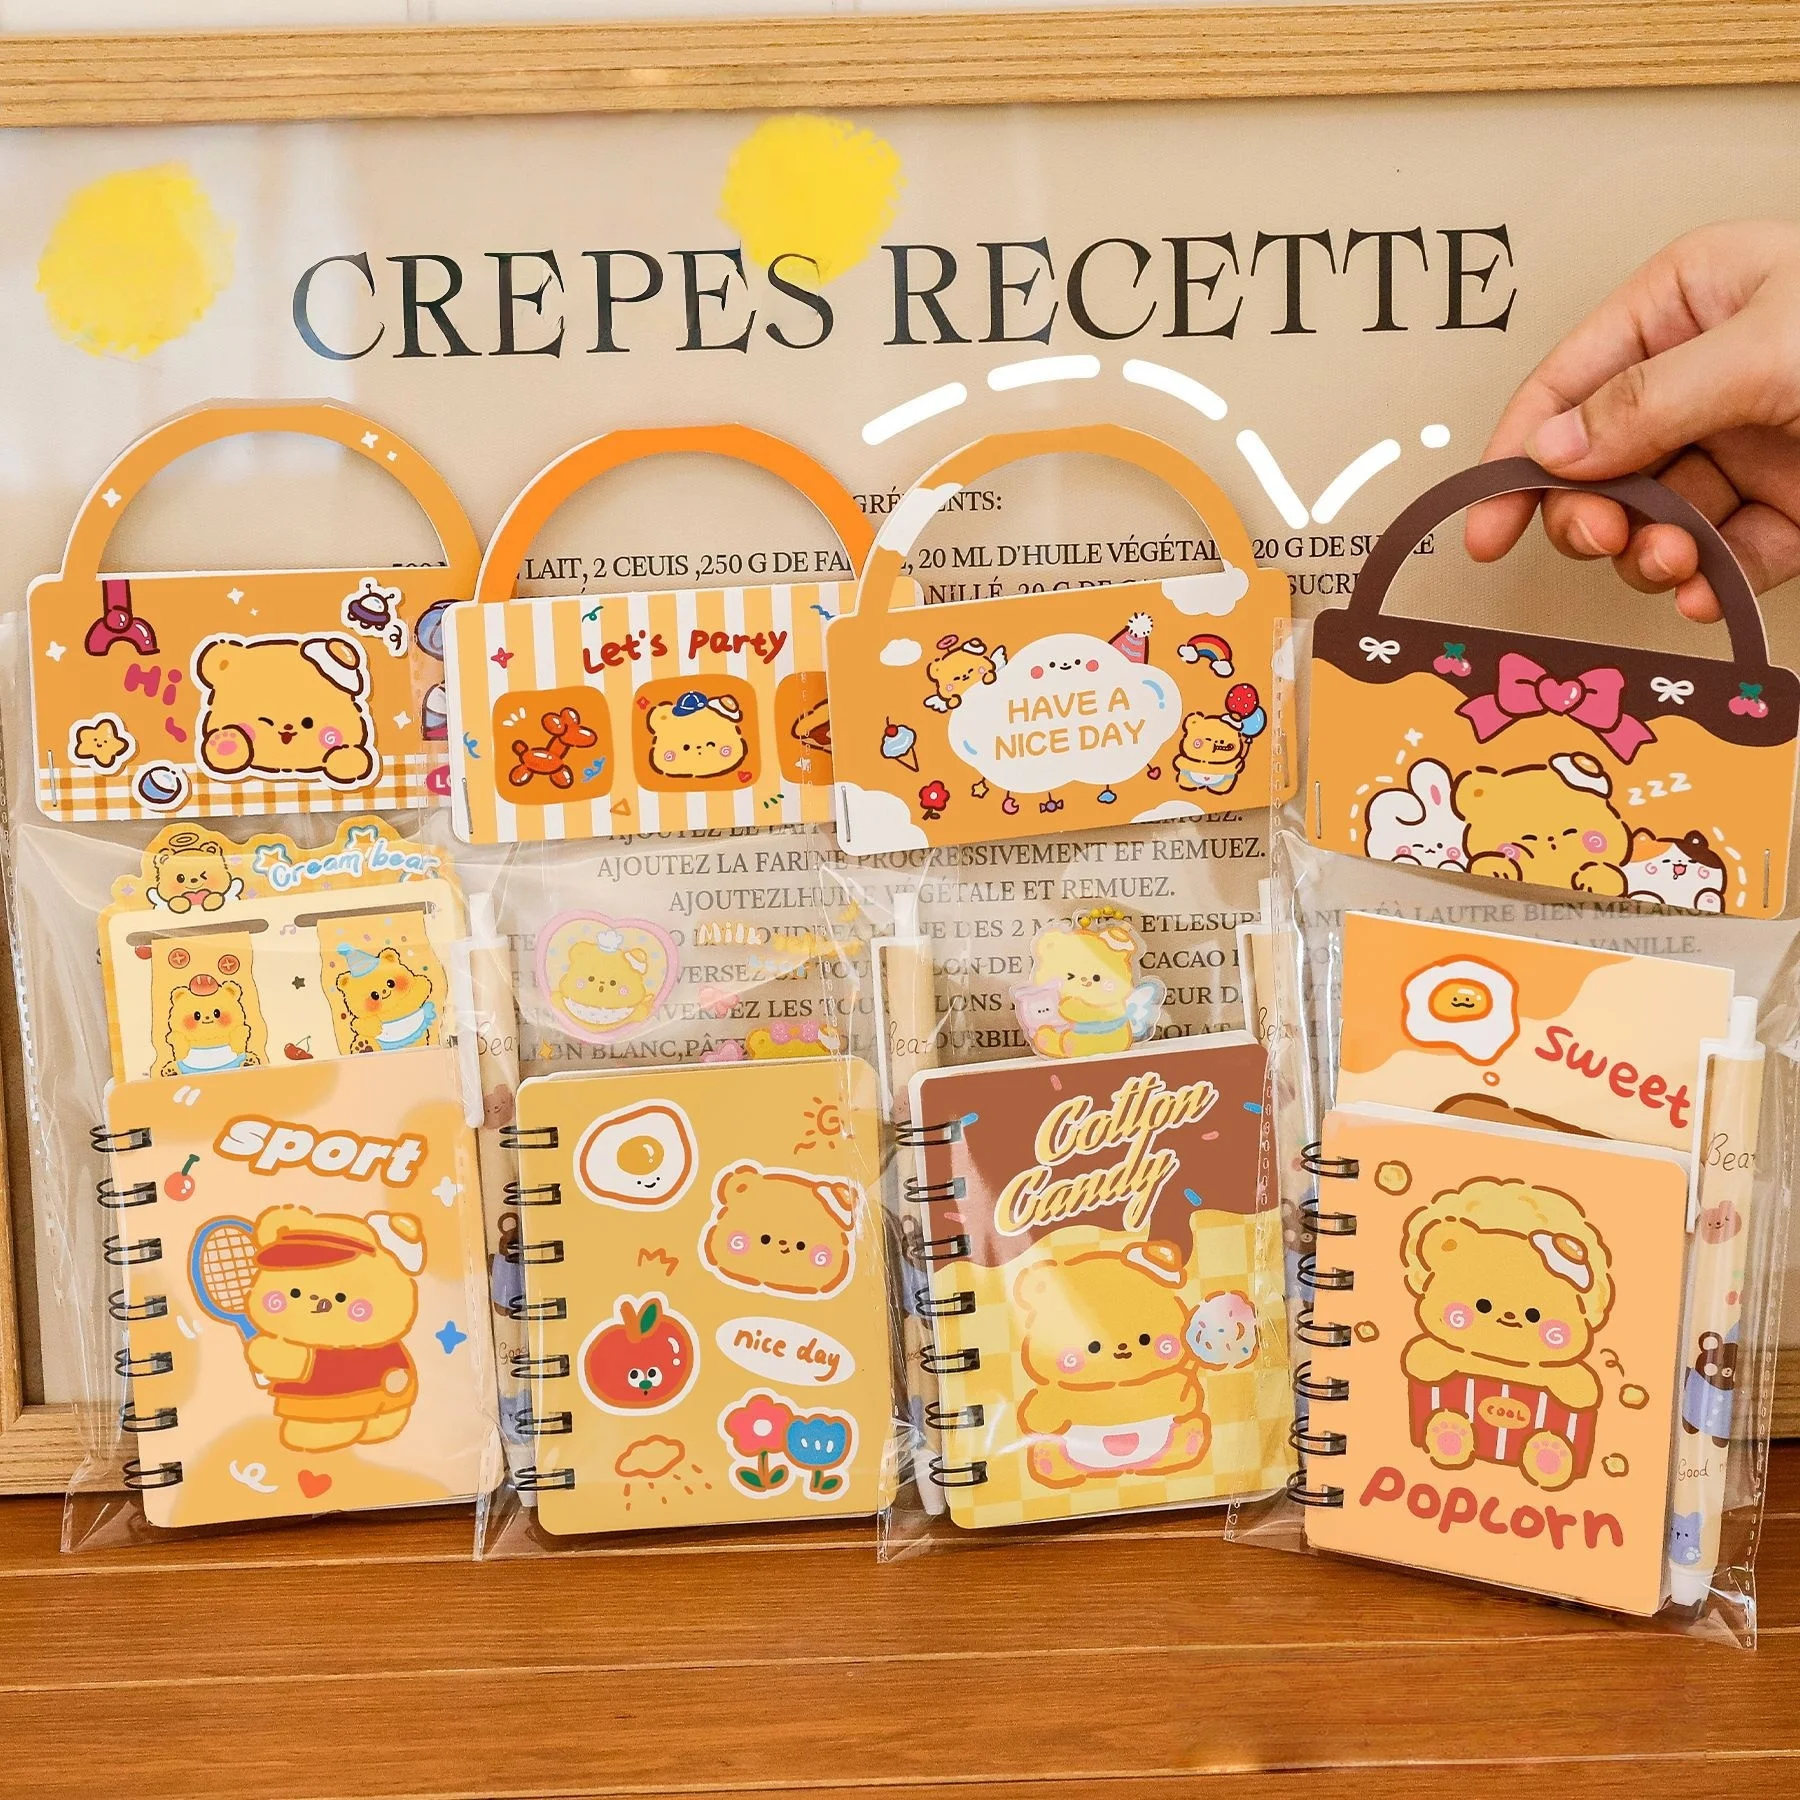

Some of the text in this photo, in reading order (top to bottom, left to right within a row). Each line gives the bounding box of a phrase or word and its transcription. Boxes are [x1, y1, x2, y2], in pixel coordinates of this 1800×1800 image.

[292, 223, 1517, 361] CREPES RECETTE
[525, 557, 588, 583] LAIT,
[593, 556, 608, 578] 2
[613, 555, 689, 577] CEUIS
[748, 552, 767, 573] G
[773, 552, 809, 573] DE
[918, 548, 947, 568] 20
[952, 546, 993, 568] ML
[997, 543, 1102, 567] D'HUILE
[1107, 534, 1221, 563] VÉGÉTAL
[1254, 539, 1279, 558] 20
[1284, 537, 1304, 558] G
[1309, 536, 1345, 557] DE
[583, 629, 669, 674] Let's
[124, 662, 183, 706] Hi
[1008, 687, 1130, 724] HAVE A
[995, 718, 1146, 761] NICE DAY
[597, 853, 712, 882] AJOUTEZ
[717, 853, 749, 873] LA
[755, 849, 848, 873] FARINE
[857, 841, 1107, 869] PROGRESSIVEMENT
[1152, 837, 1266, 861] REMUEZ.
[1023, 879, 1055, 901] ET
[1062, 876, 1175, 900] REMUEZ.
[1139, 949, 1226, 970] CACAO
[768, 999, 812, 1018] LES
[1035, 1072, 1219, 1166] Cotton
[217, 1116, 425, 1186] sport
[994, 1130, 1181, 1236] Candy
[733, 1327, 842, 1382] nice day
